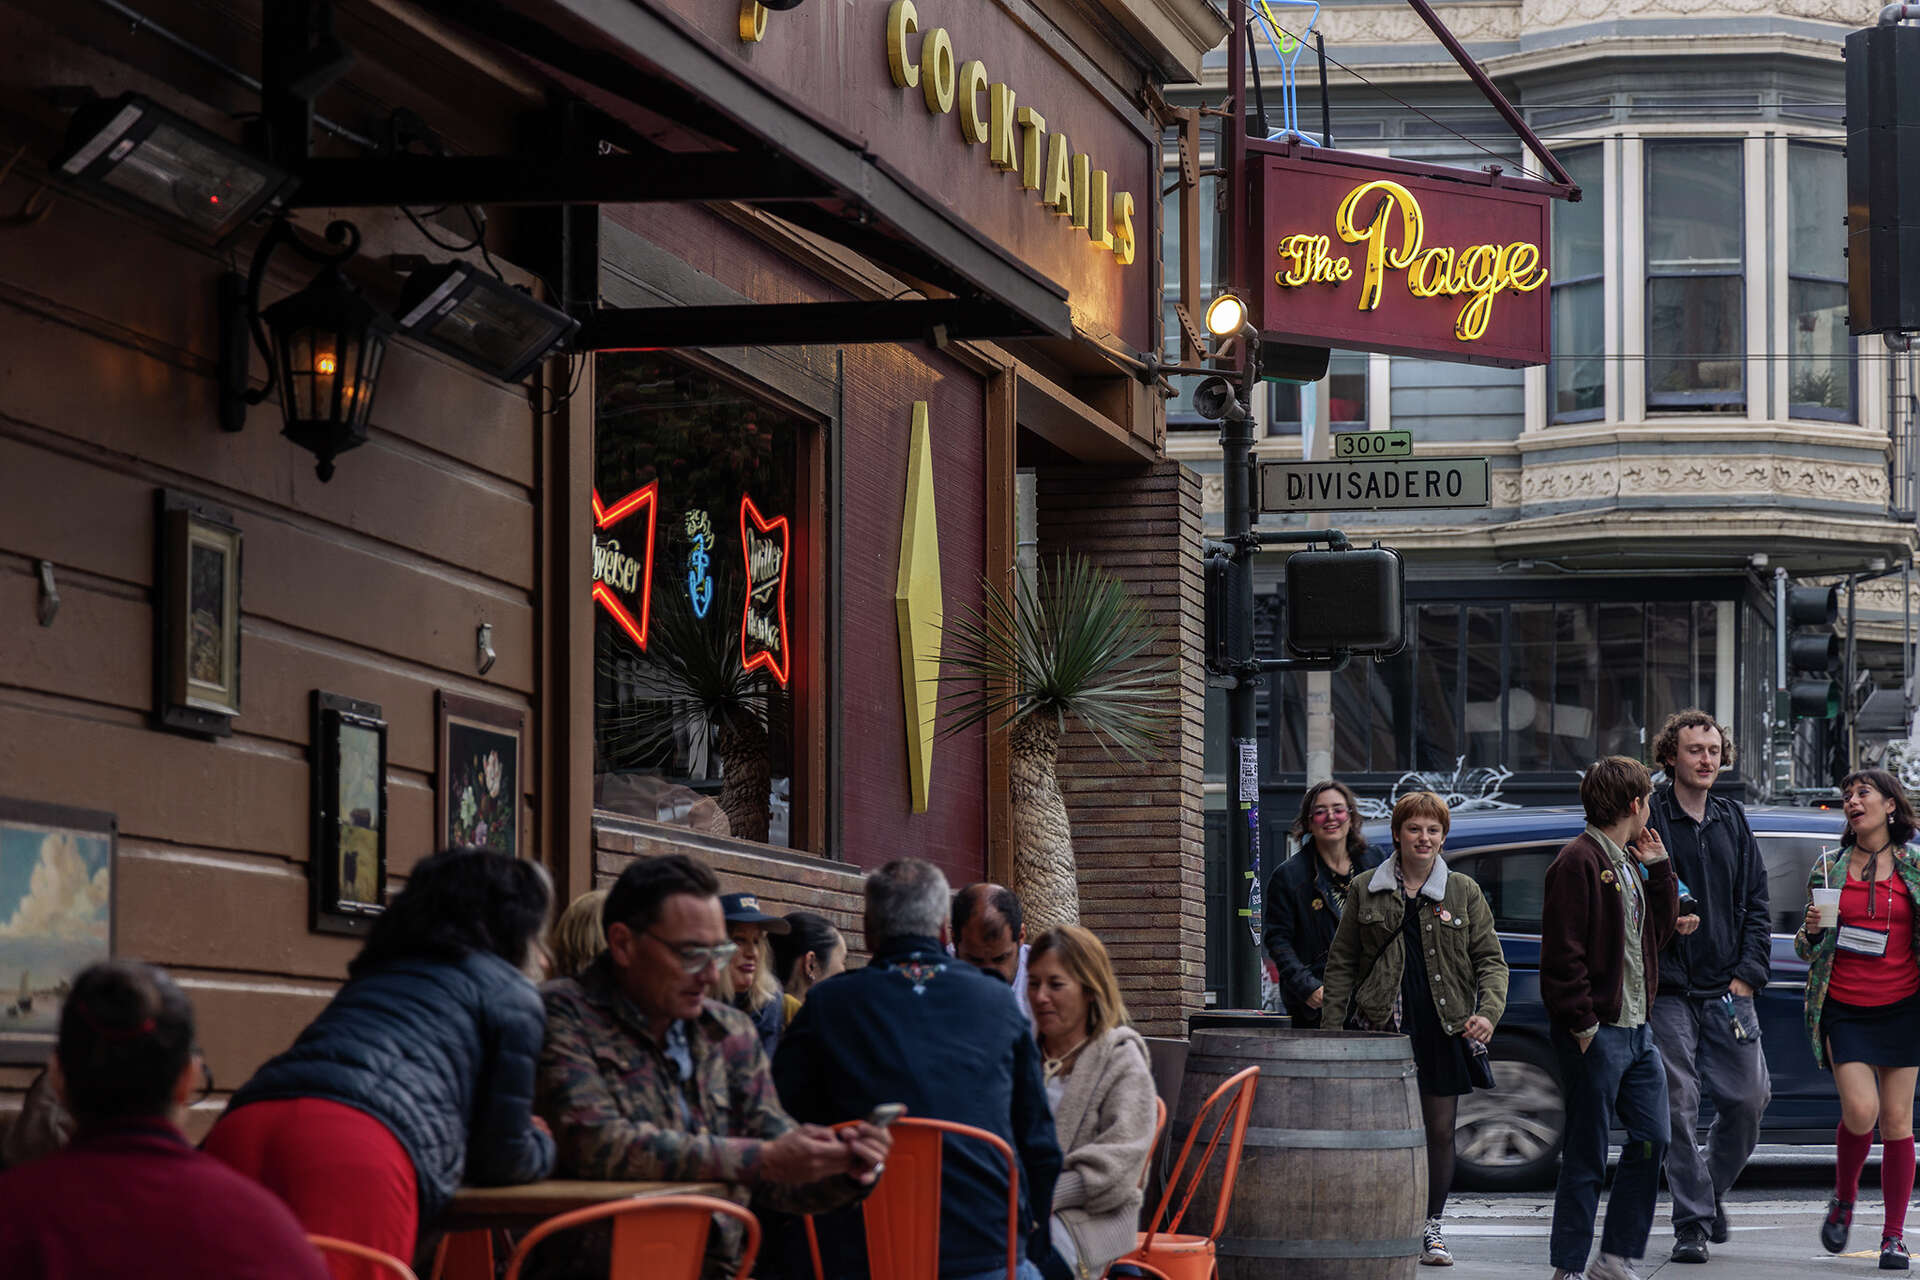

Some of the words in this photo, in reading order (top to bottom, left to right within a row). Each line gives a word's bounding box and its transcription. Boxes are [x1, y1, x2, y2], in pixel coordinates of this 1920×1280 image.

[887, 0, 1136, 266] COCKTAILS
[1275, 233, 1353, 288] The
[1336, 179, 1549, 342] Page
[1286, 468, 1463, 501] DIVISADERO
[1342, 435, 1387, 455] 300
